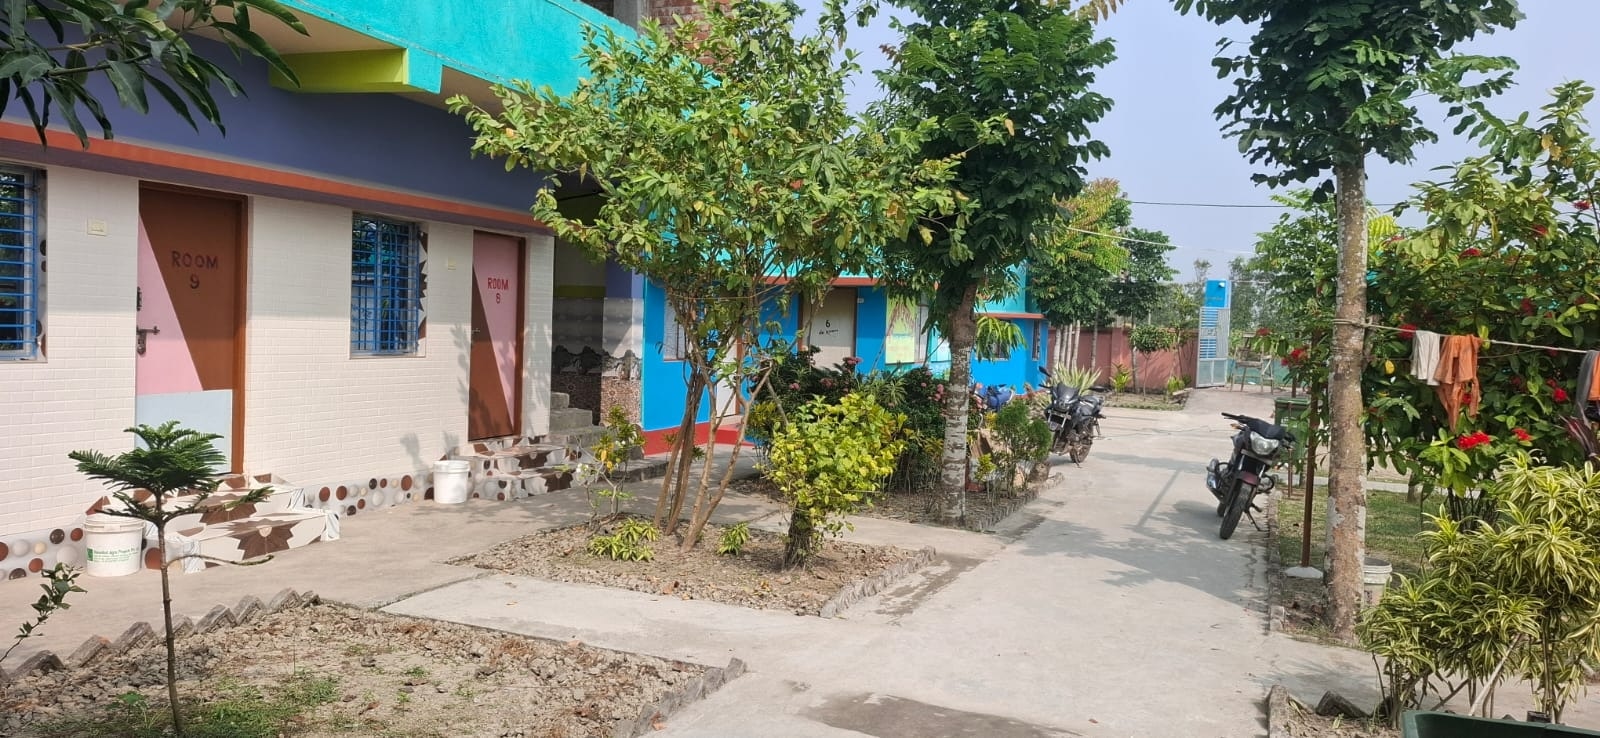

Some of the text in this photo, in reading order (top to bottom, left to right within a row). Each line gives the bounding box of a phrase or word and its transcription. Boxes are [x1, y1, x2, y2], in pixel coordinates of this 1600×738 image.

[171, 250, 218, 269] ROOM
[190, 273, 200, 290] 9
[487, 277, 509, 290] ROOM
[825, 319, 831, 328] 6
